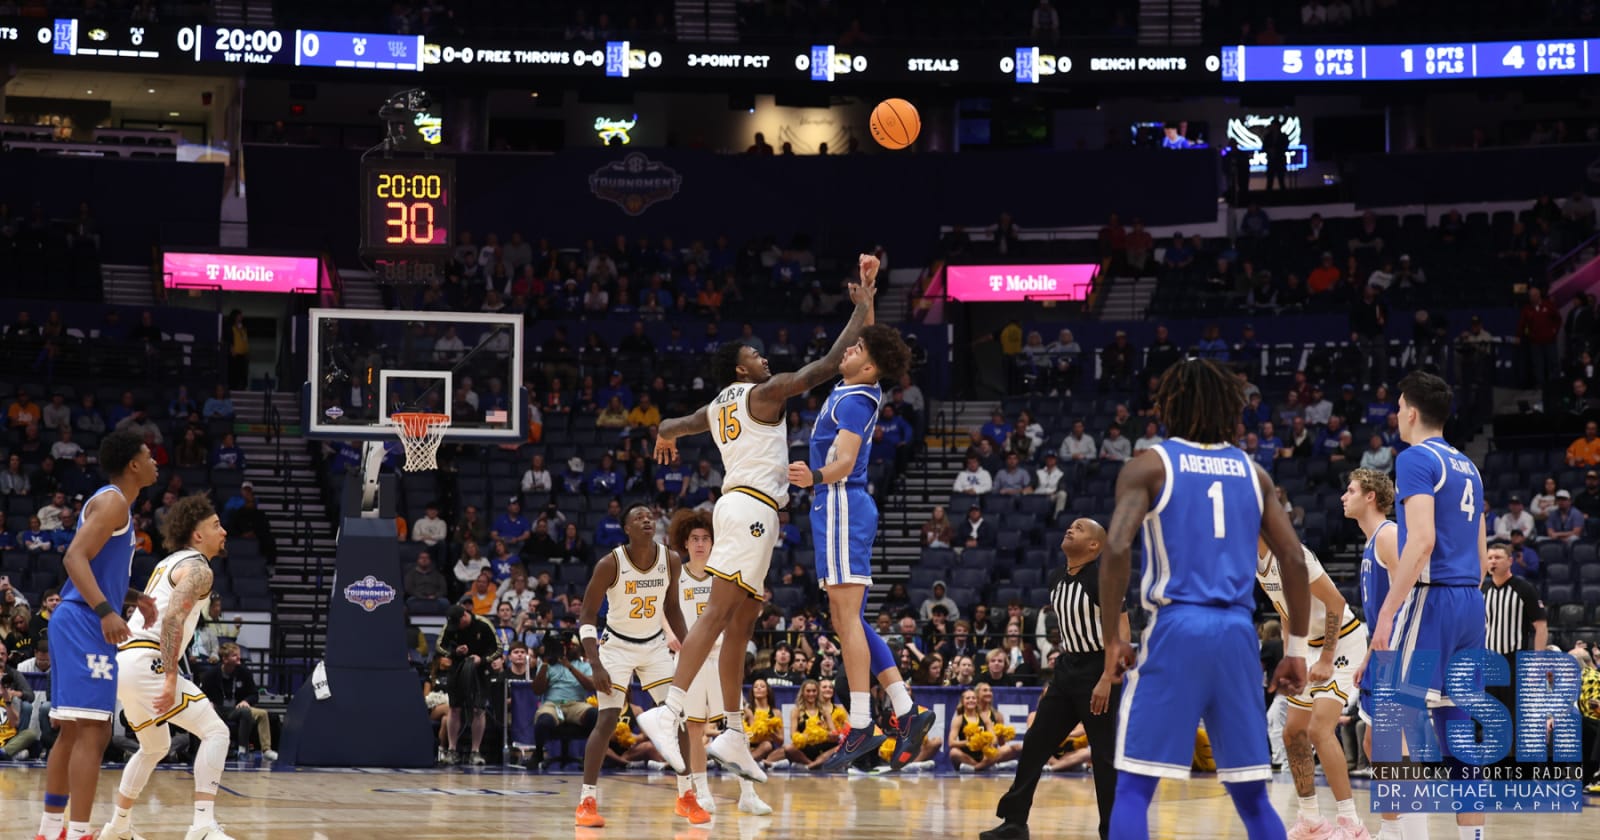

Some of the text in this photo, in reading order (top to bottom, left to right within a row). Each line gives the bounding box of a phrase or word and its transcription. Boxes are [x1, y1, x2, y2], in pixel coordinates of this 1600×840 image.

[37, 27, 52, 44] 0
[177, 27, 195, 52] 0
[215, 28, 282, 52] 20:00
[302, 34, 320, 57] 0
[224, 51, 242, 63] 1ST
[443, 46, 474, 64] 0-0
[477, 50, 512, 63] FREE
[514, 50, 570, 64] THROWS
[573, 49, 605, 67] 0-0
[1315, 48, 1354, 62] 0 PTS
[1426, 47, 1464, 61] 0 PTS
[1502, 45, 1525, 69] 4
[1536, 42, 1576, 57] 0 PTS
[648, 51, 662, 68] 0
[687, 54, 741, 68] 3-POINT
[743, 55, 770, 68] PCT
[795, 54, 810, 71] 0
[853, 55, 867, 72] 0
[908, 58, 960, 72] STEALS
[1000, 56, 1014, 73] 0
[1058, 56, 1072, 73] 0
[1090, 58, 1136, 71] BENCH
[1138, 58, 1187, 71] POINTS
[1205, 55, 1220, 72] 0
[1282, 49, 1304, 74] 5
[1315, 61, 1354, 76] 0 FLS
[1400, 48, 1413, 73] 1
[1426, 60, 1464, 75] 0 FLS
[1536, 56, 1576, 71] 0 FLS
[377, 174, 441, 199] 20:00
[386, 202, 434, 244] 30
[223, 265, 275, 283] Mobile
[1005, 274, 1057, 292] Mobile
[718, 402, 742, 445] 15
[1180, 453, 1247, 478] ABERDEEN
[1207, 481, 1226, 539] 1
[1460, 478, 1475, 522] 4
[625, 579, 664, 594] MISSOURI
[629, 596, 657, 619] 25
[86, 653, 114, 681] UK
